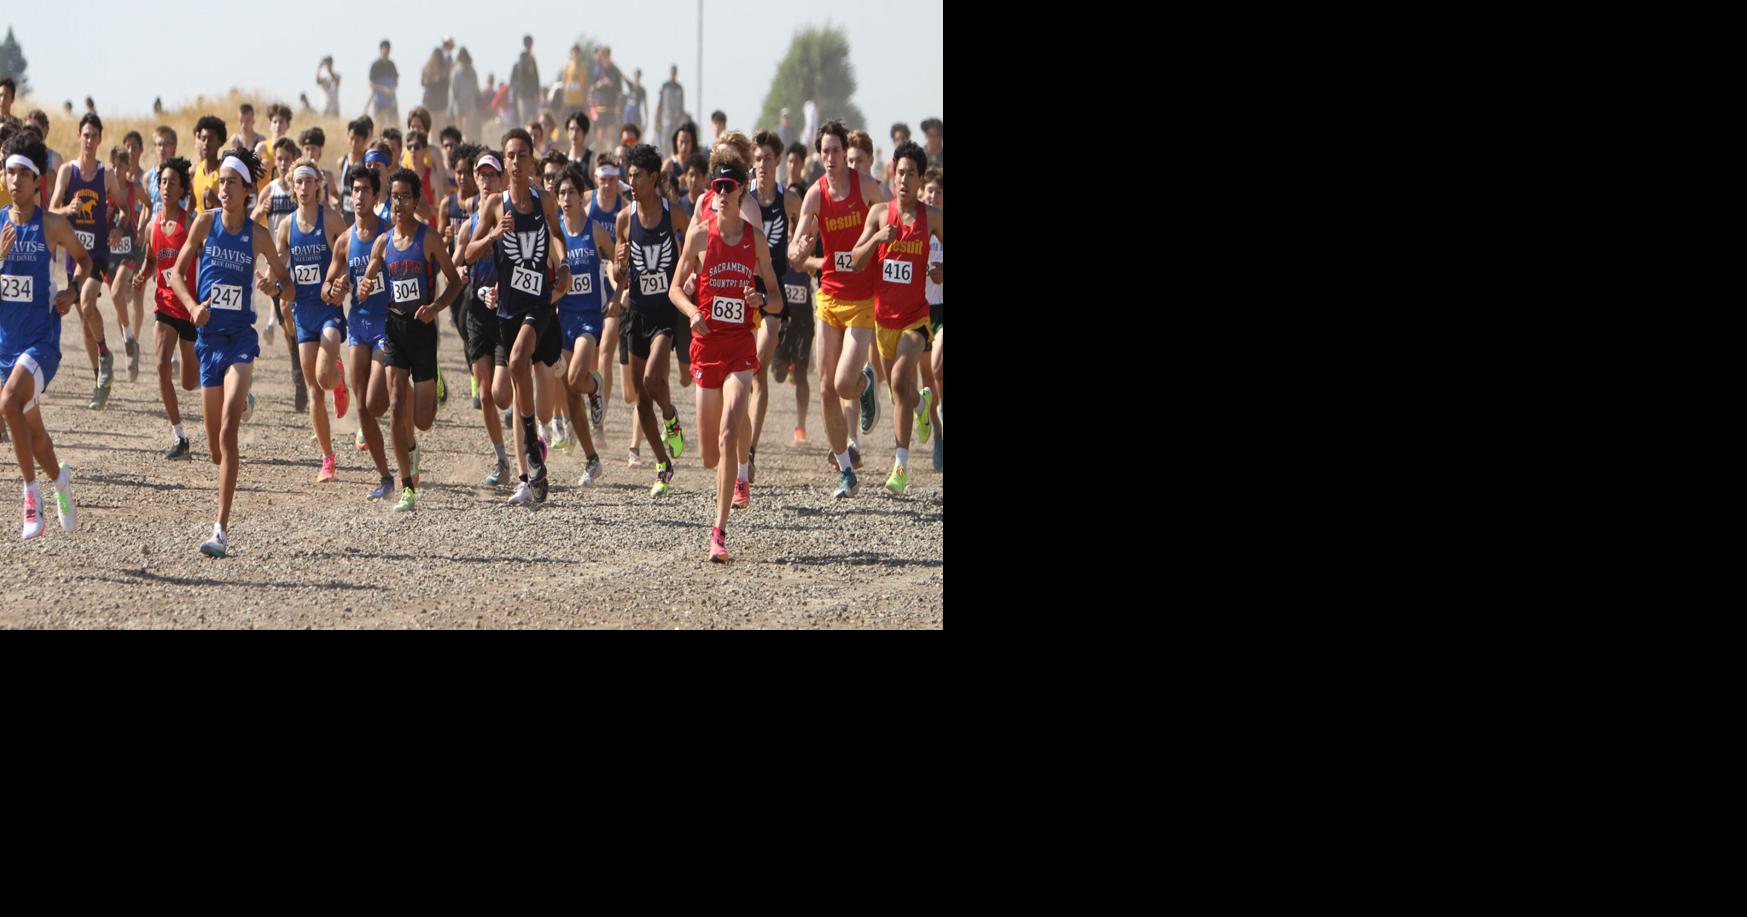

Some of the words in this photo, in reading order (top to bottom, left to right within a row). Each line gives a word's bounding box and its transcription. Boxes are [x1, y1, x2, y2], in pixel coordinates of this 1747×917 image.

[11, 240, 38, 253] AVIS
[212, 245, 246, 264] DAVIS
[295, 244, 321, 255] DAVIS
[297, 267, 319, 282] 227
[709, 261, 753, 279] SACRAMENTO
[884, 263, 911, 281] 416
[2, 278, 31, 298] 234
[394, 282, 419, 300] 304
[515, 270, 541, 294] 781
[642, 276, 667, 292] 791
[709, 278, 737, 288] COUNTRY
[212, 286, 242, 307] 247
[714, 300, 743, 320] 683
